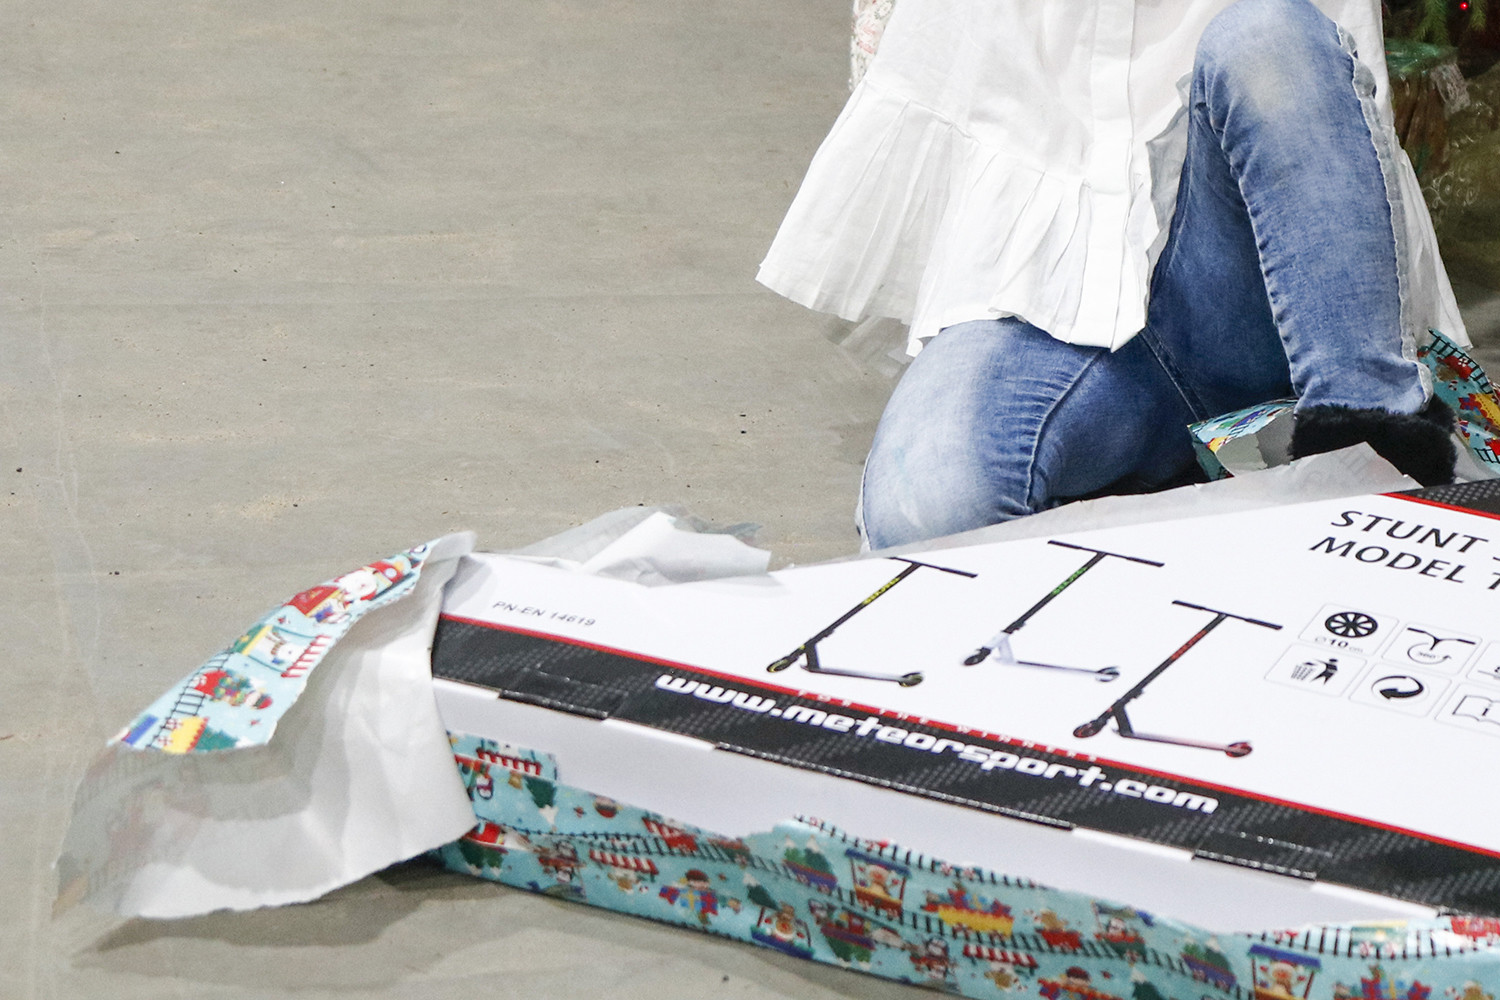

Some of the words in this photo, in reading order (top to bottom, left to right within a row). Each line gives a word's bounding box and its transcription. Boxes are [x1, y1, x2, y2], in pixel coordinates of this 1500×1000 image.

[1331, 510, 1489, 554] STUNT
[1308, 536, 1466, 584] MODEL
[492, 600, 545, 617] PN-EN
[549, 611, 597, 627] 14619
[655, 673, 1220, 814] www.meteorsport.com
